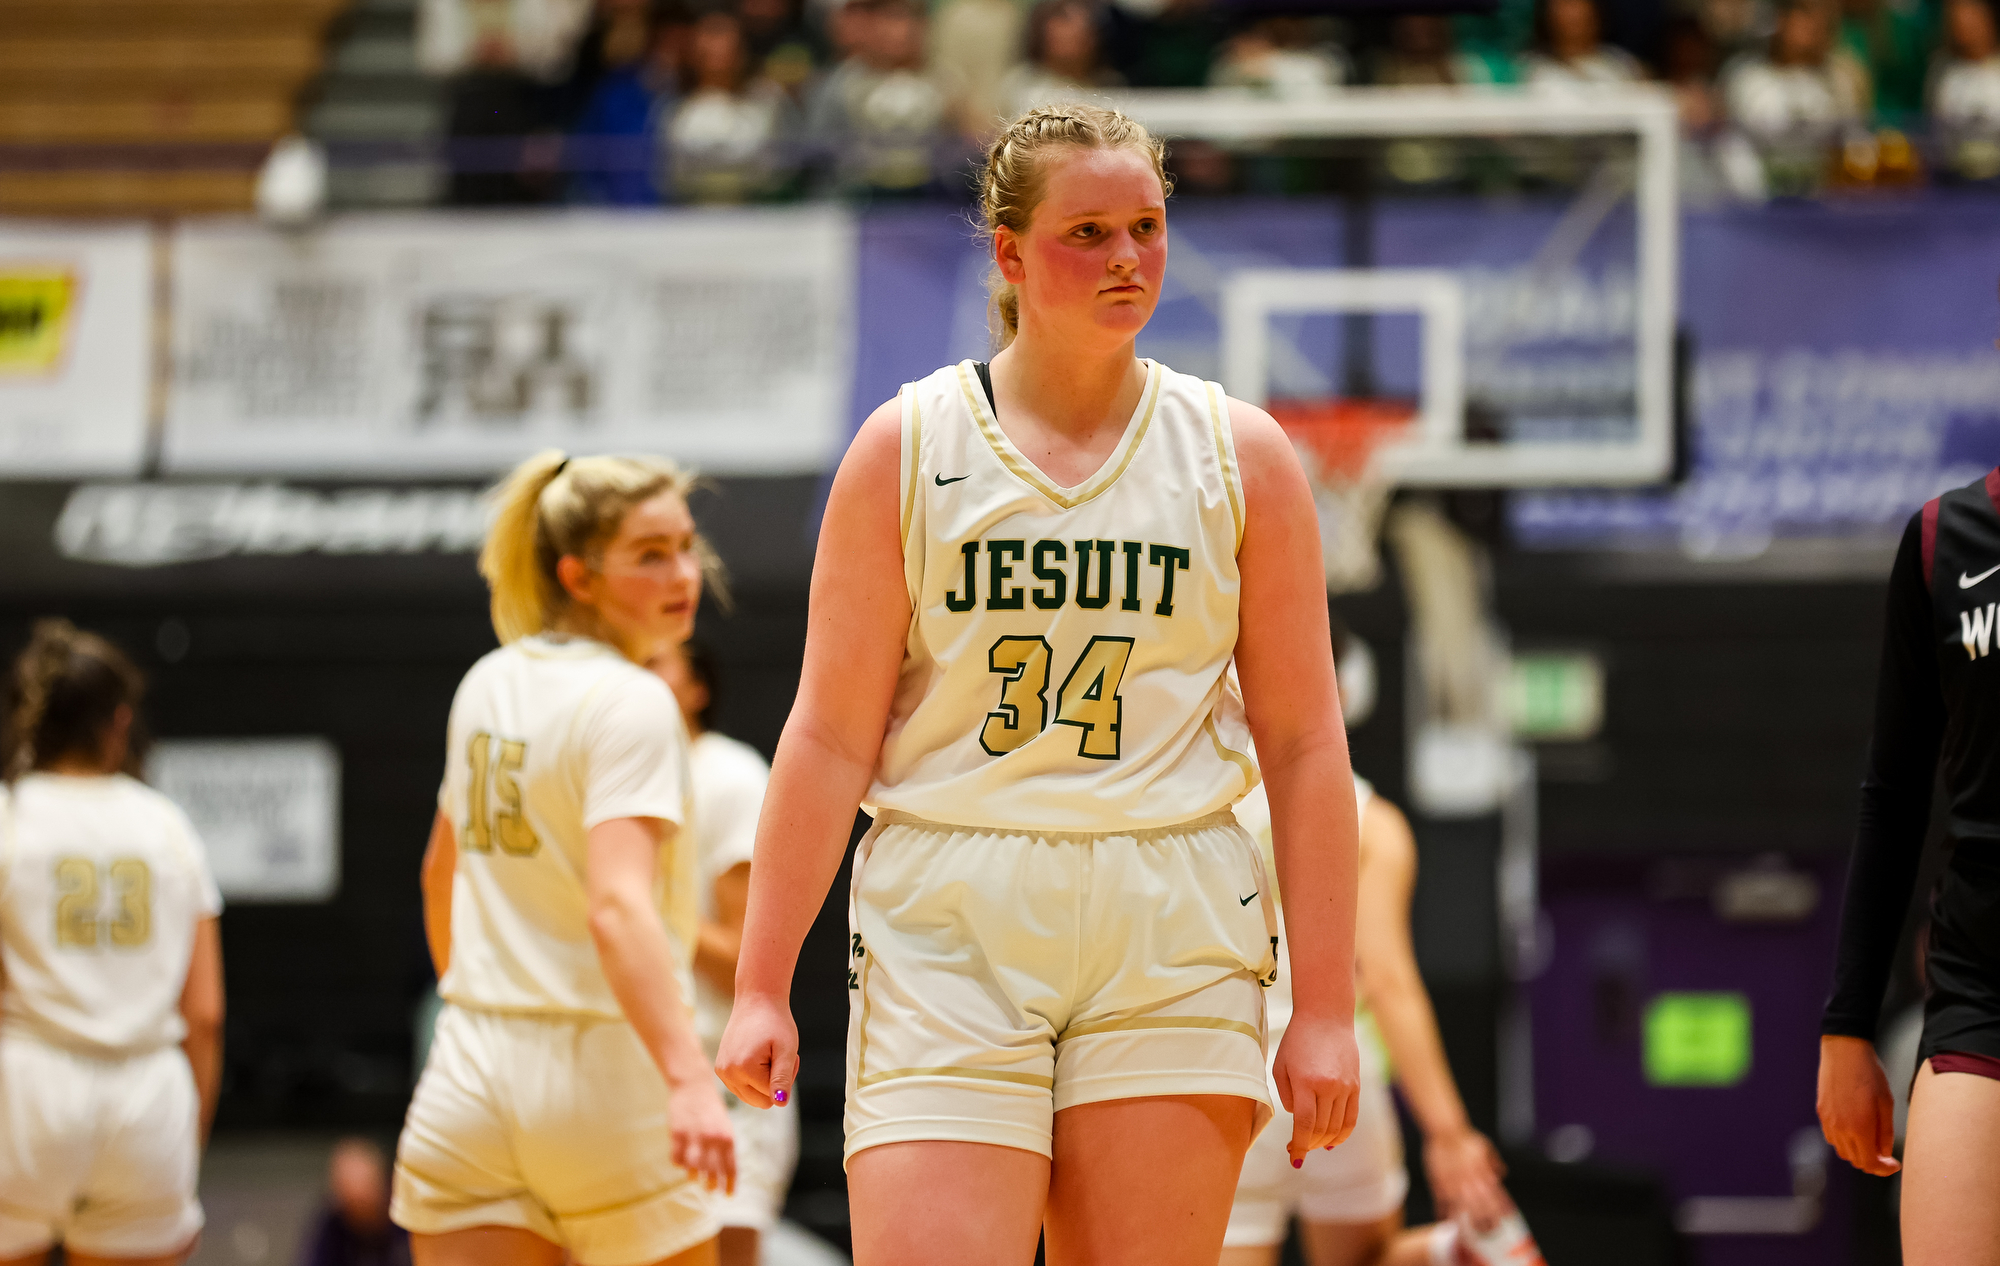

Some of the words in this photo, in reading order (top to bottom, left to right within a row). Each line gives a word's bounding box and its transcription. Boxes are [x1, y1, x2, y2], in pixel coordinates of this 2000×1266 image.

[944, 537, 1191, 618] JESUIT
[1960, 602, 2000, 661] W
[979, 635, 1135, 760] 34
[463, 732, 541, 857] 15
[54, 854, 153, 950] 23
